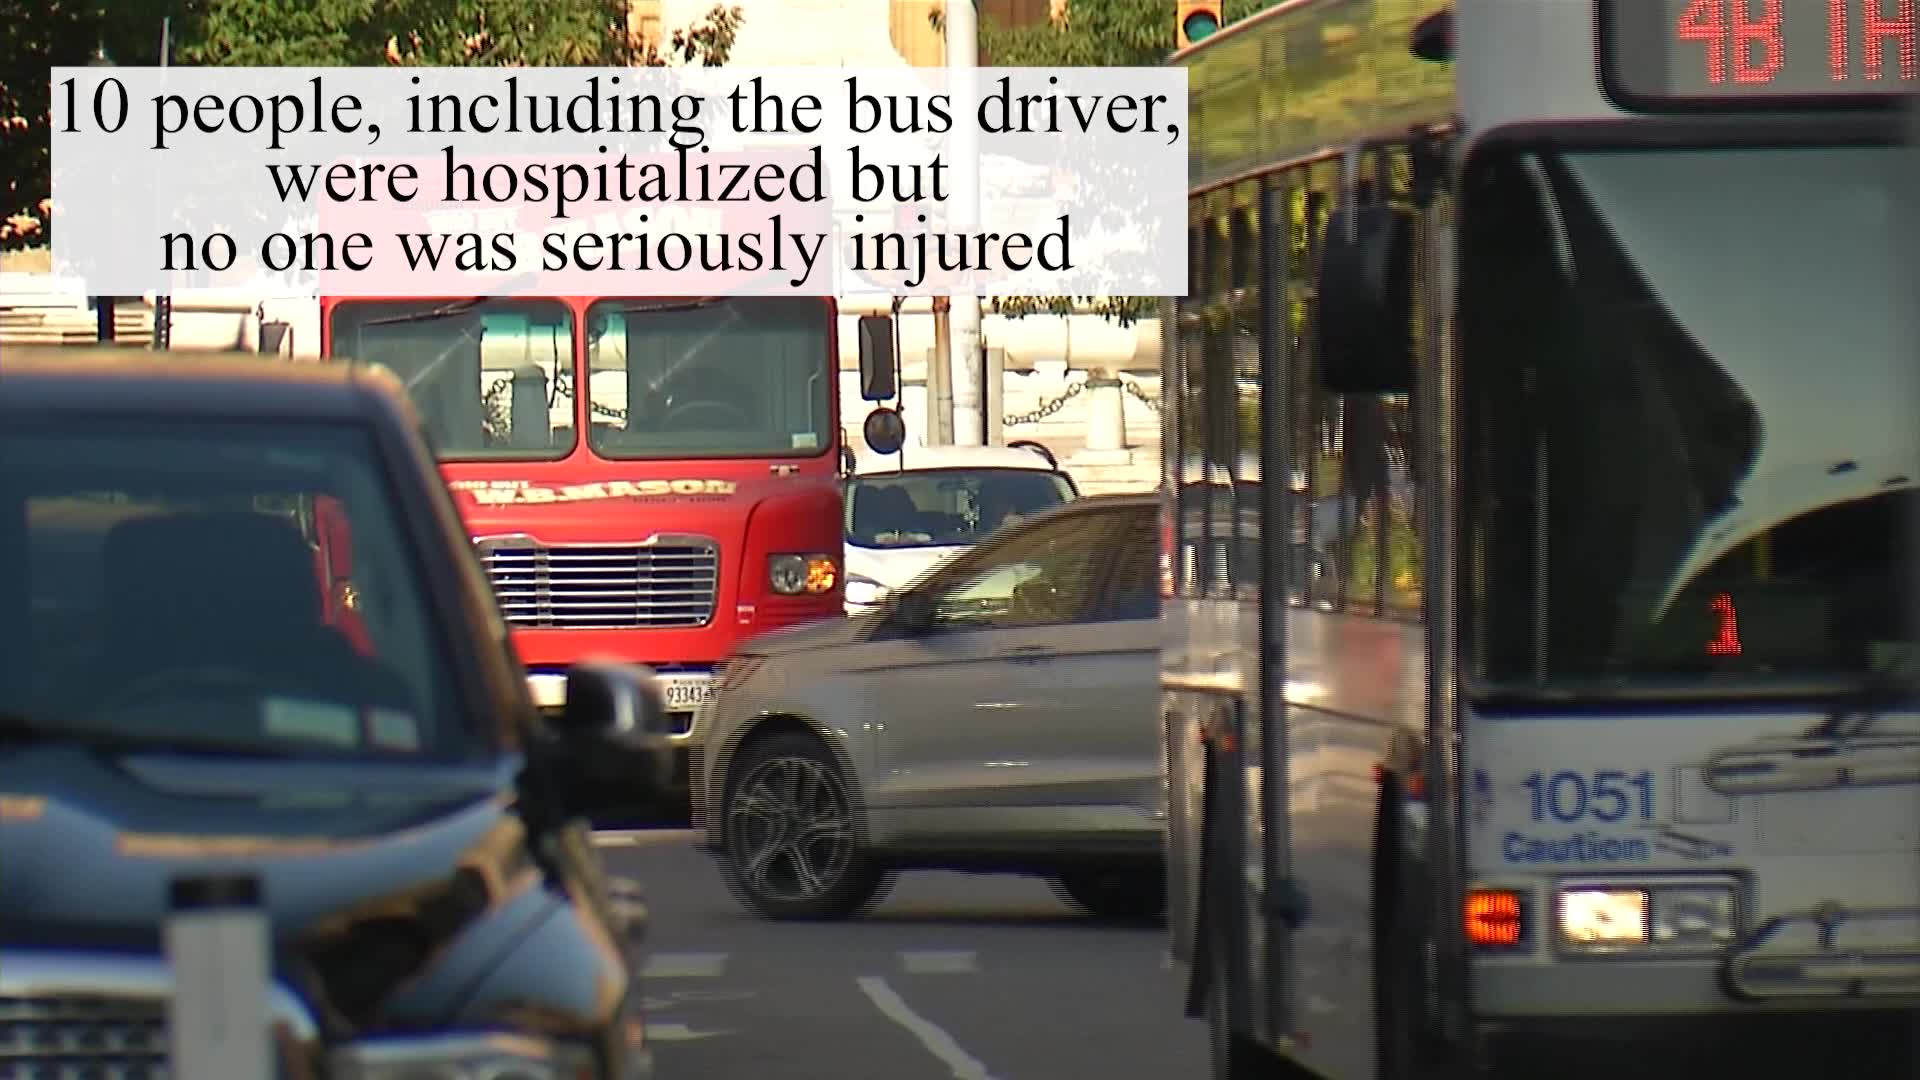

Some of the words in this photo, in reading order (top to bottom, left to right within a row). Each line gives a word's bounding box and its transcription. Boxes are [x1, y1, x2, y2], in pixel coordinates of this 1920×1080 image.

[1706, 592, 1742, 657] 1
[1521, 768, 1656, 823] 1051
[1502, 830, 1650, 864] Caution
